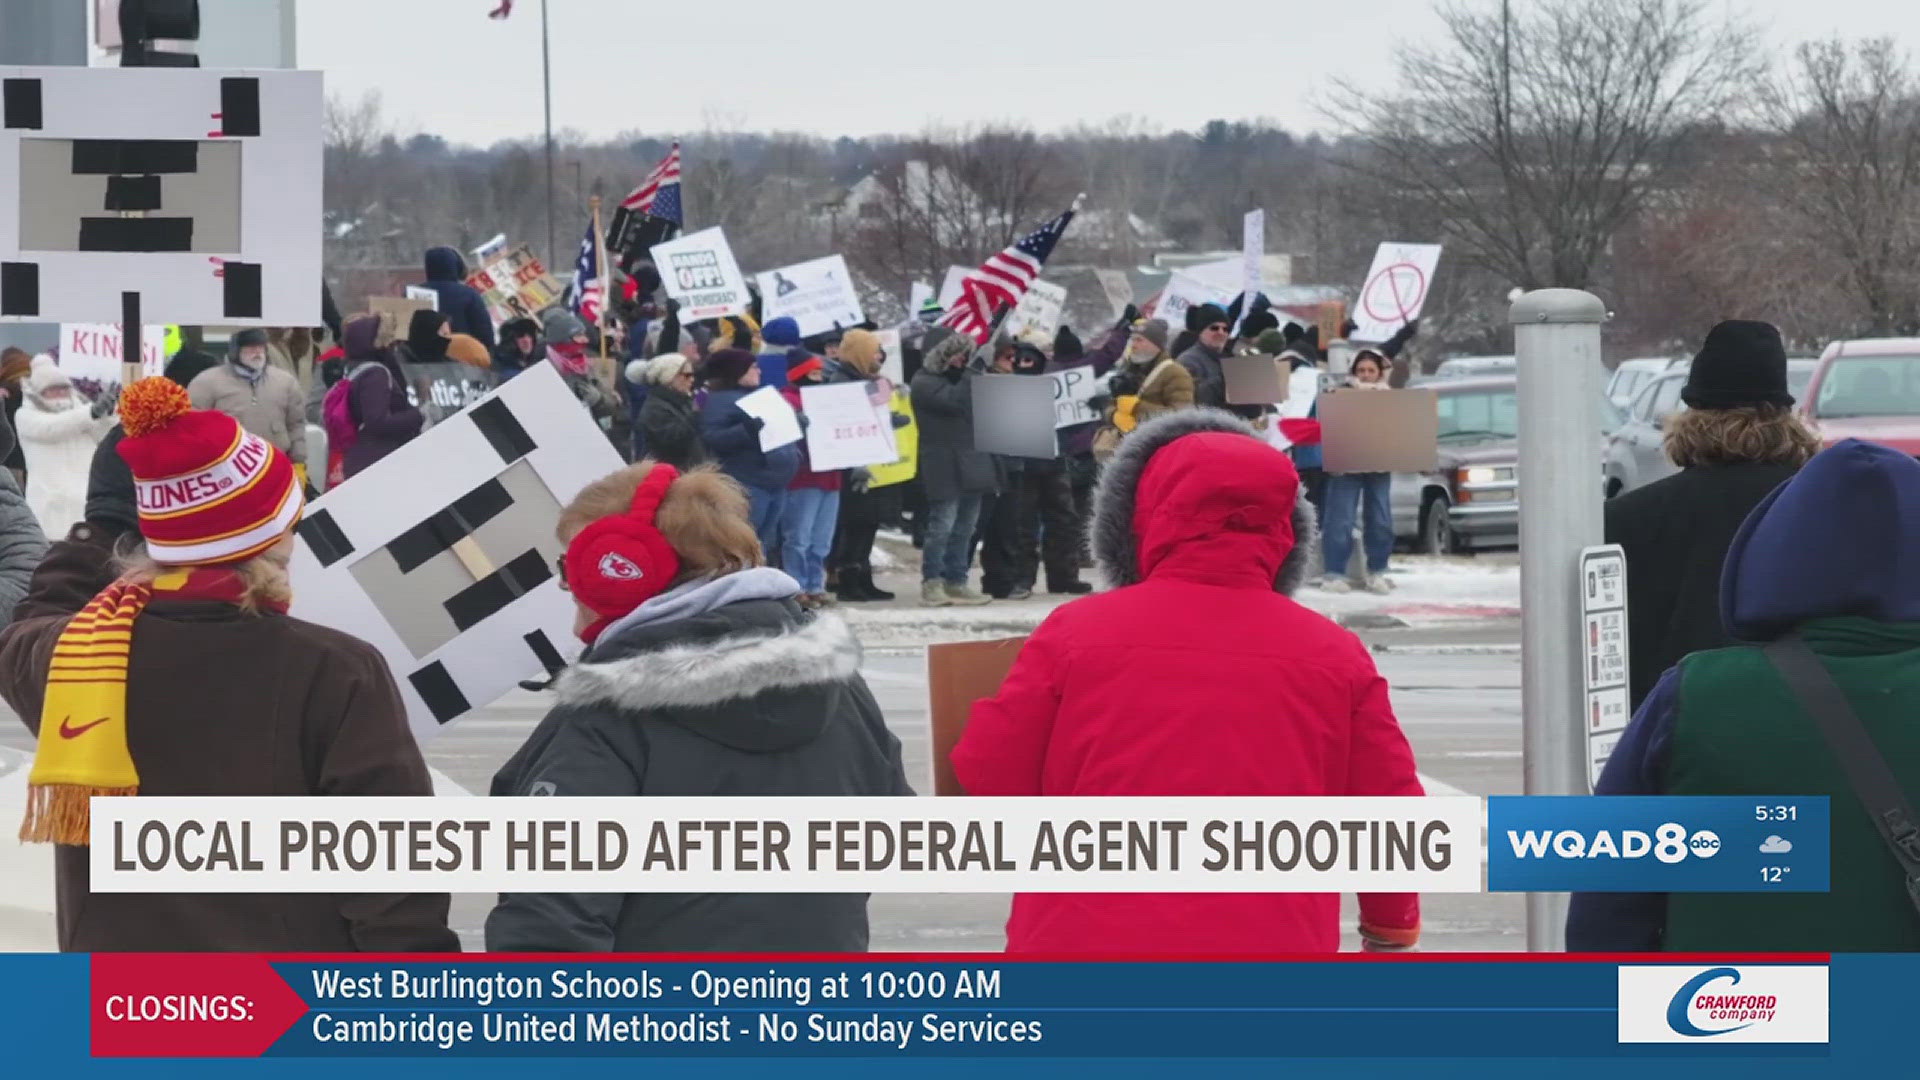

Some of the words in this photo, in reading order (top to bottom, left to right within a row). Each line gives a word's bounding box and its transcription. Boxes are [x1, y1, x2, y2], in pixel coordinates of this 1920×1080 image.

[676, 266, 724, 289] OFF!
[72, 330, 157, 373] KIN!
[137, 473, 220, 509] LONES
